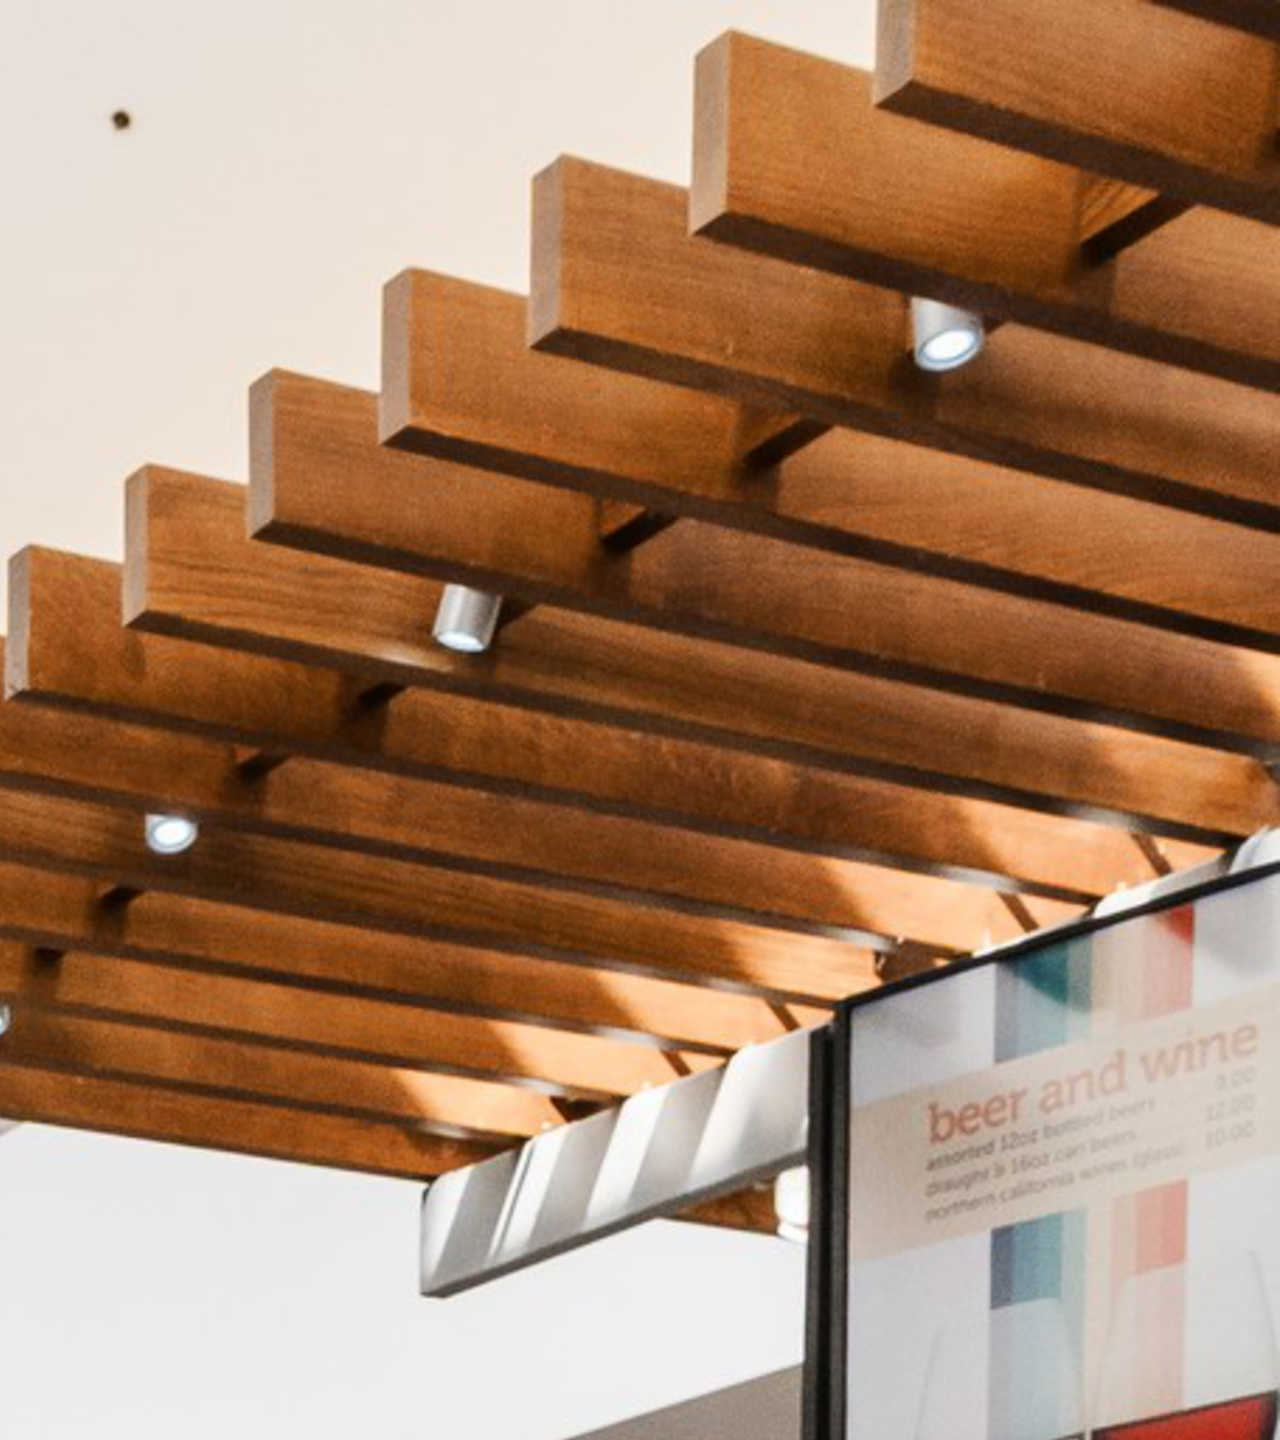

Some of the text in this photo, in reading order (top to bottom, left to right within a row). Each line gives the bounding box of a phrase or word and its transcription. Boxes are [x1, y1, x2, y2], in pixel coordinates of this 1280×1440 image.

[926, 1024, 1260, 1146] beer and wine
